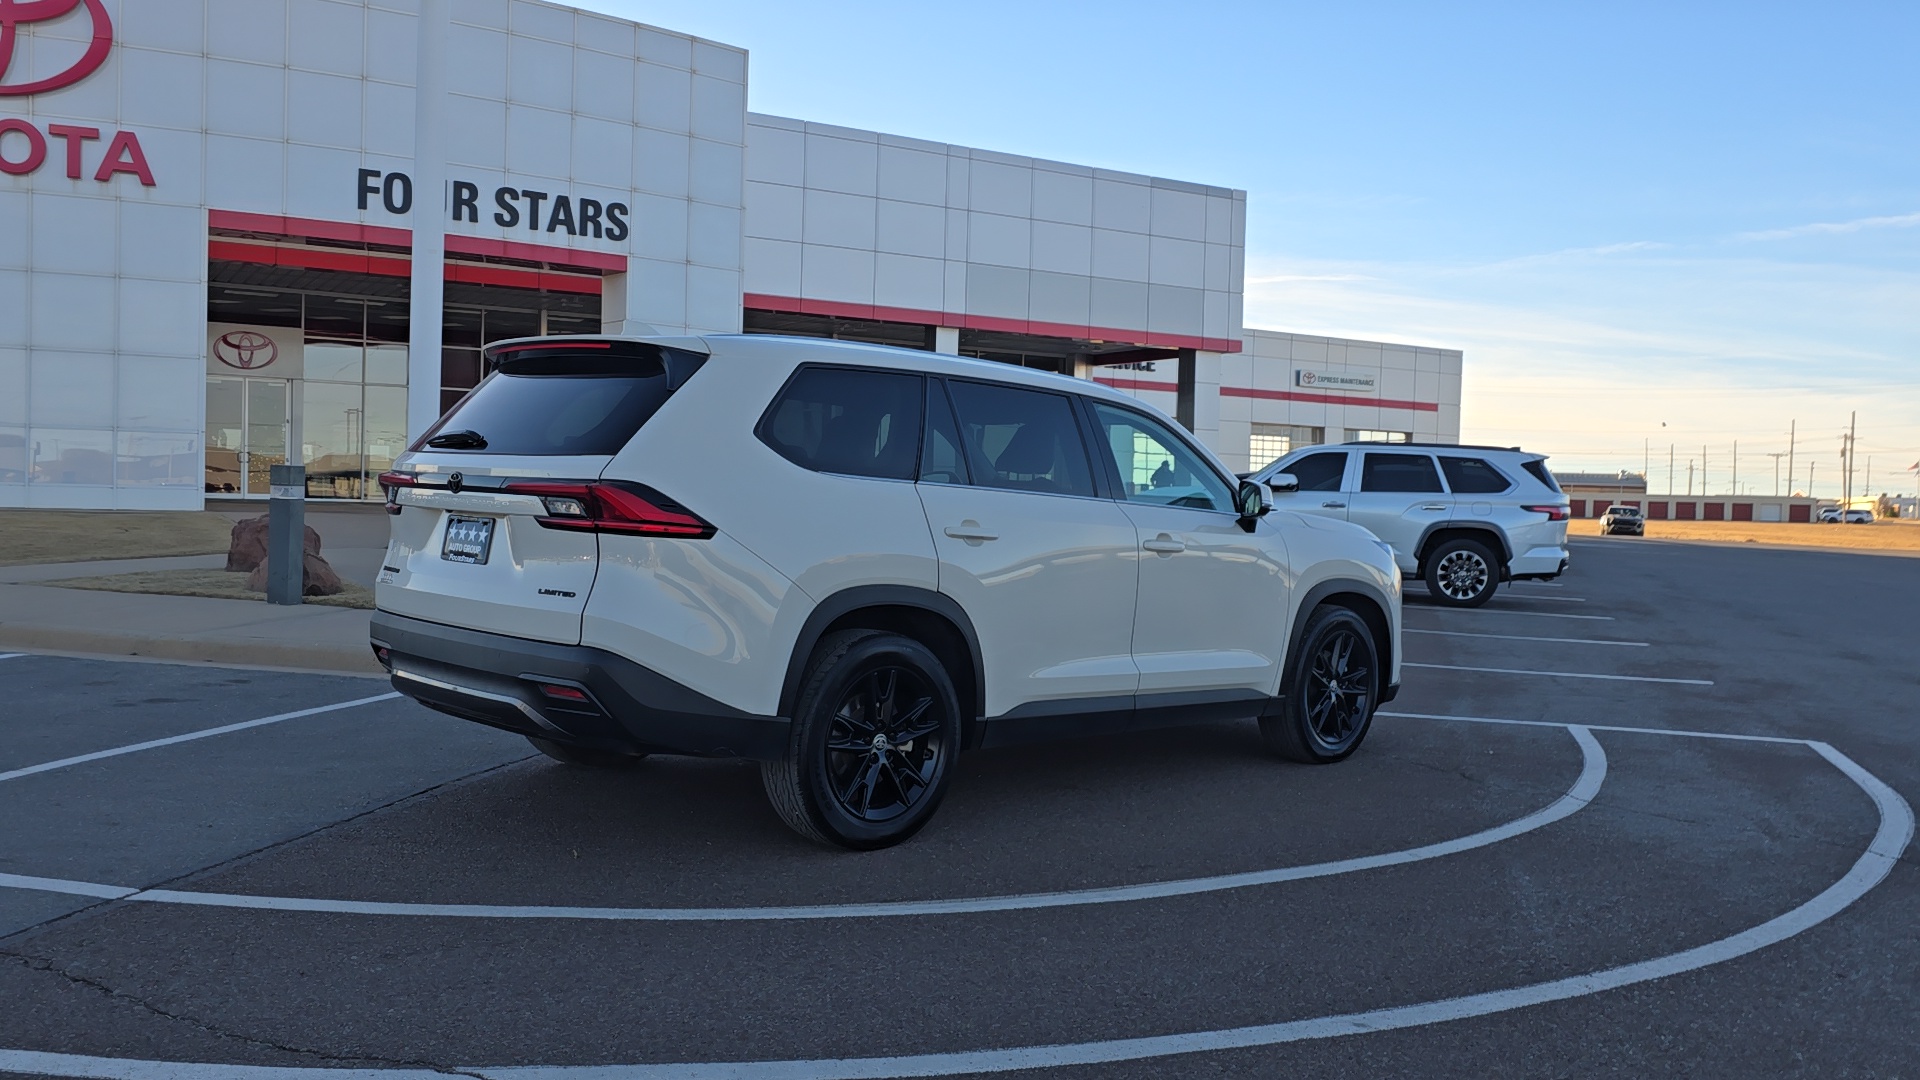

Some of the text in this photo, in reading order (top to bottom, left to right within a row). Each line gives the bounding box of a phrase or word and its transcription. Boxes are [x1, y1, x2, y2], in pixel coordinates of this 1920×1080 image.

[357, 168, 629, 241] FOR STARS
[1317, 375, 1375, 387] EXPRESS MAINTENANCE
[448, 542, 482, 554] AUTO GROUP
[537, 588, 576, 598] LIMITED
